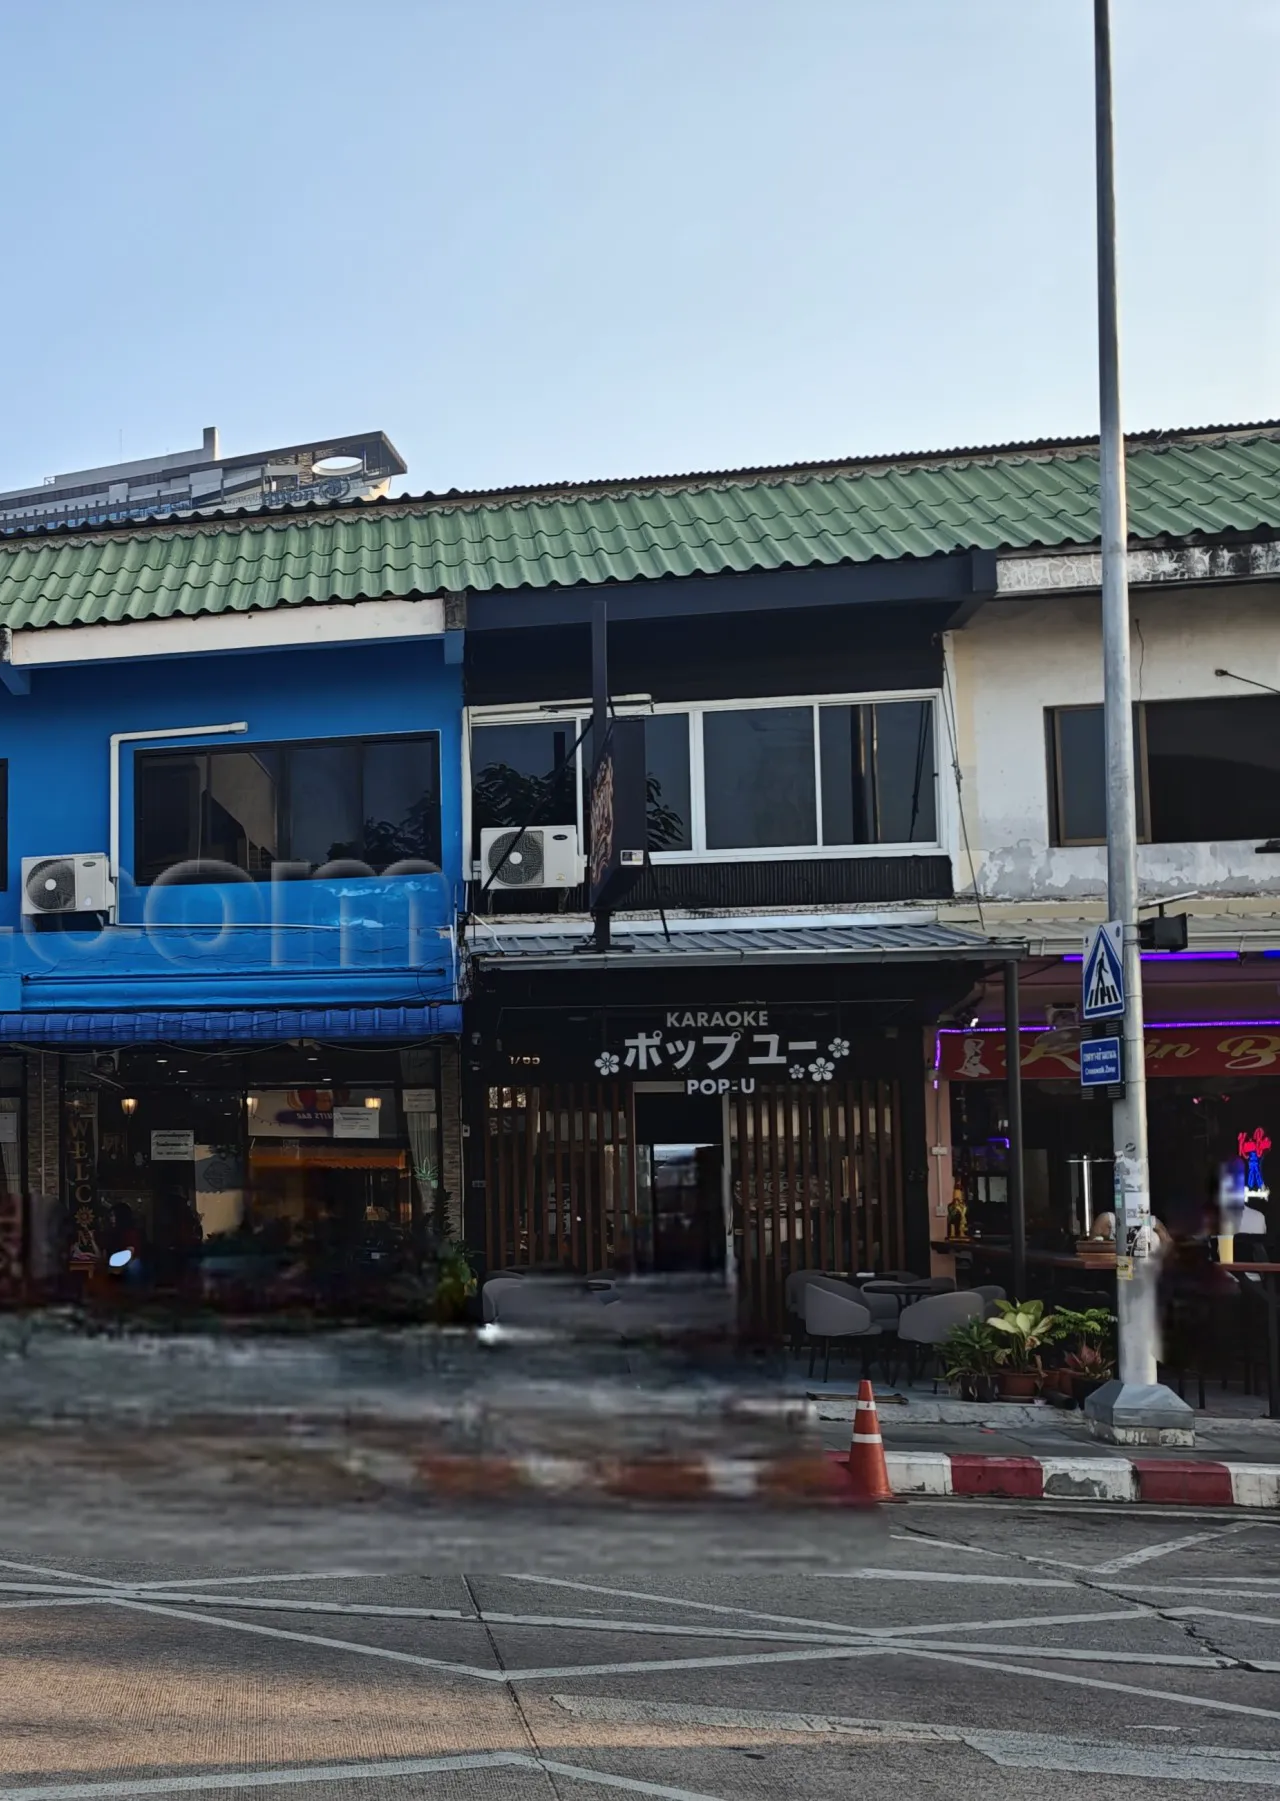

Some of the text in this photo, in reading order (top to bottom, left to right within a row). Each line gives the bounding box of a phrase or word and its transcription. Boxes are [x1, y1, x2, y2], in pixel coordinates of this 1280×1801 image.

[666, 1010, 769, 1028] KARAOKE
[624, 1030, 818, 1071] ポップユー
[687, 1077, 755, 1095] POP-U
